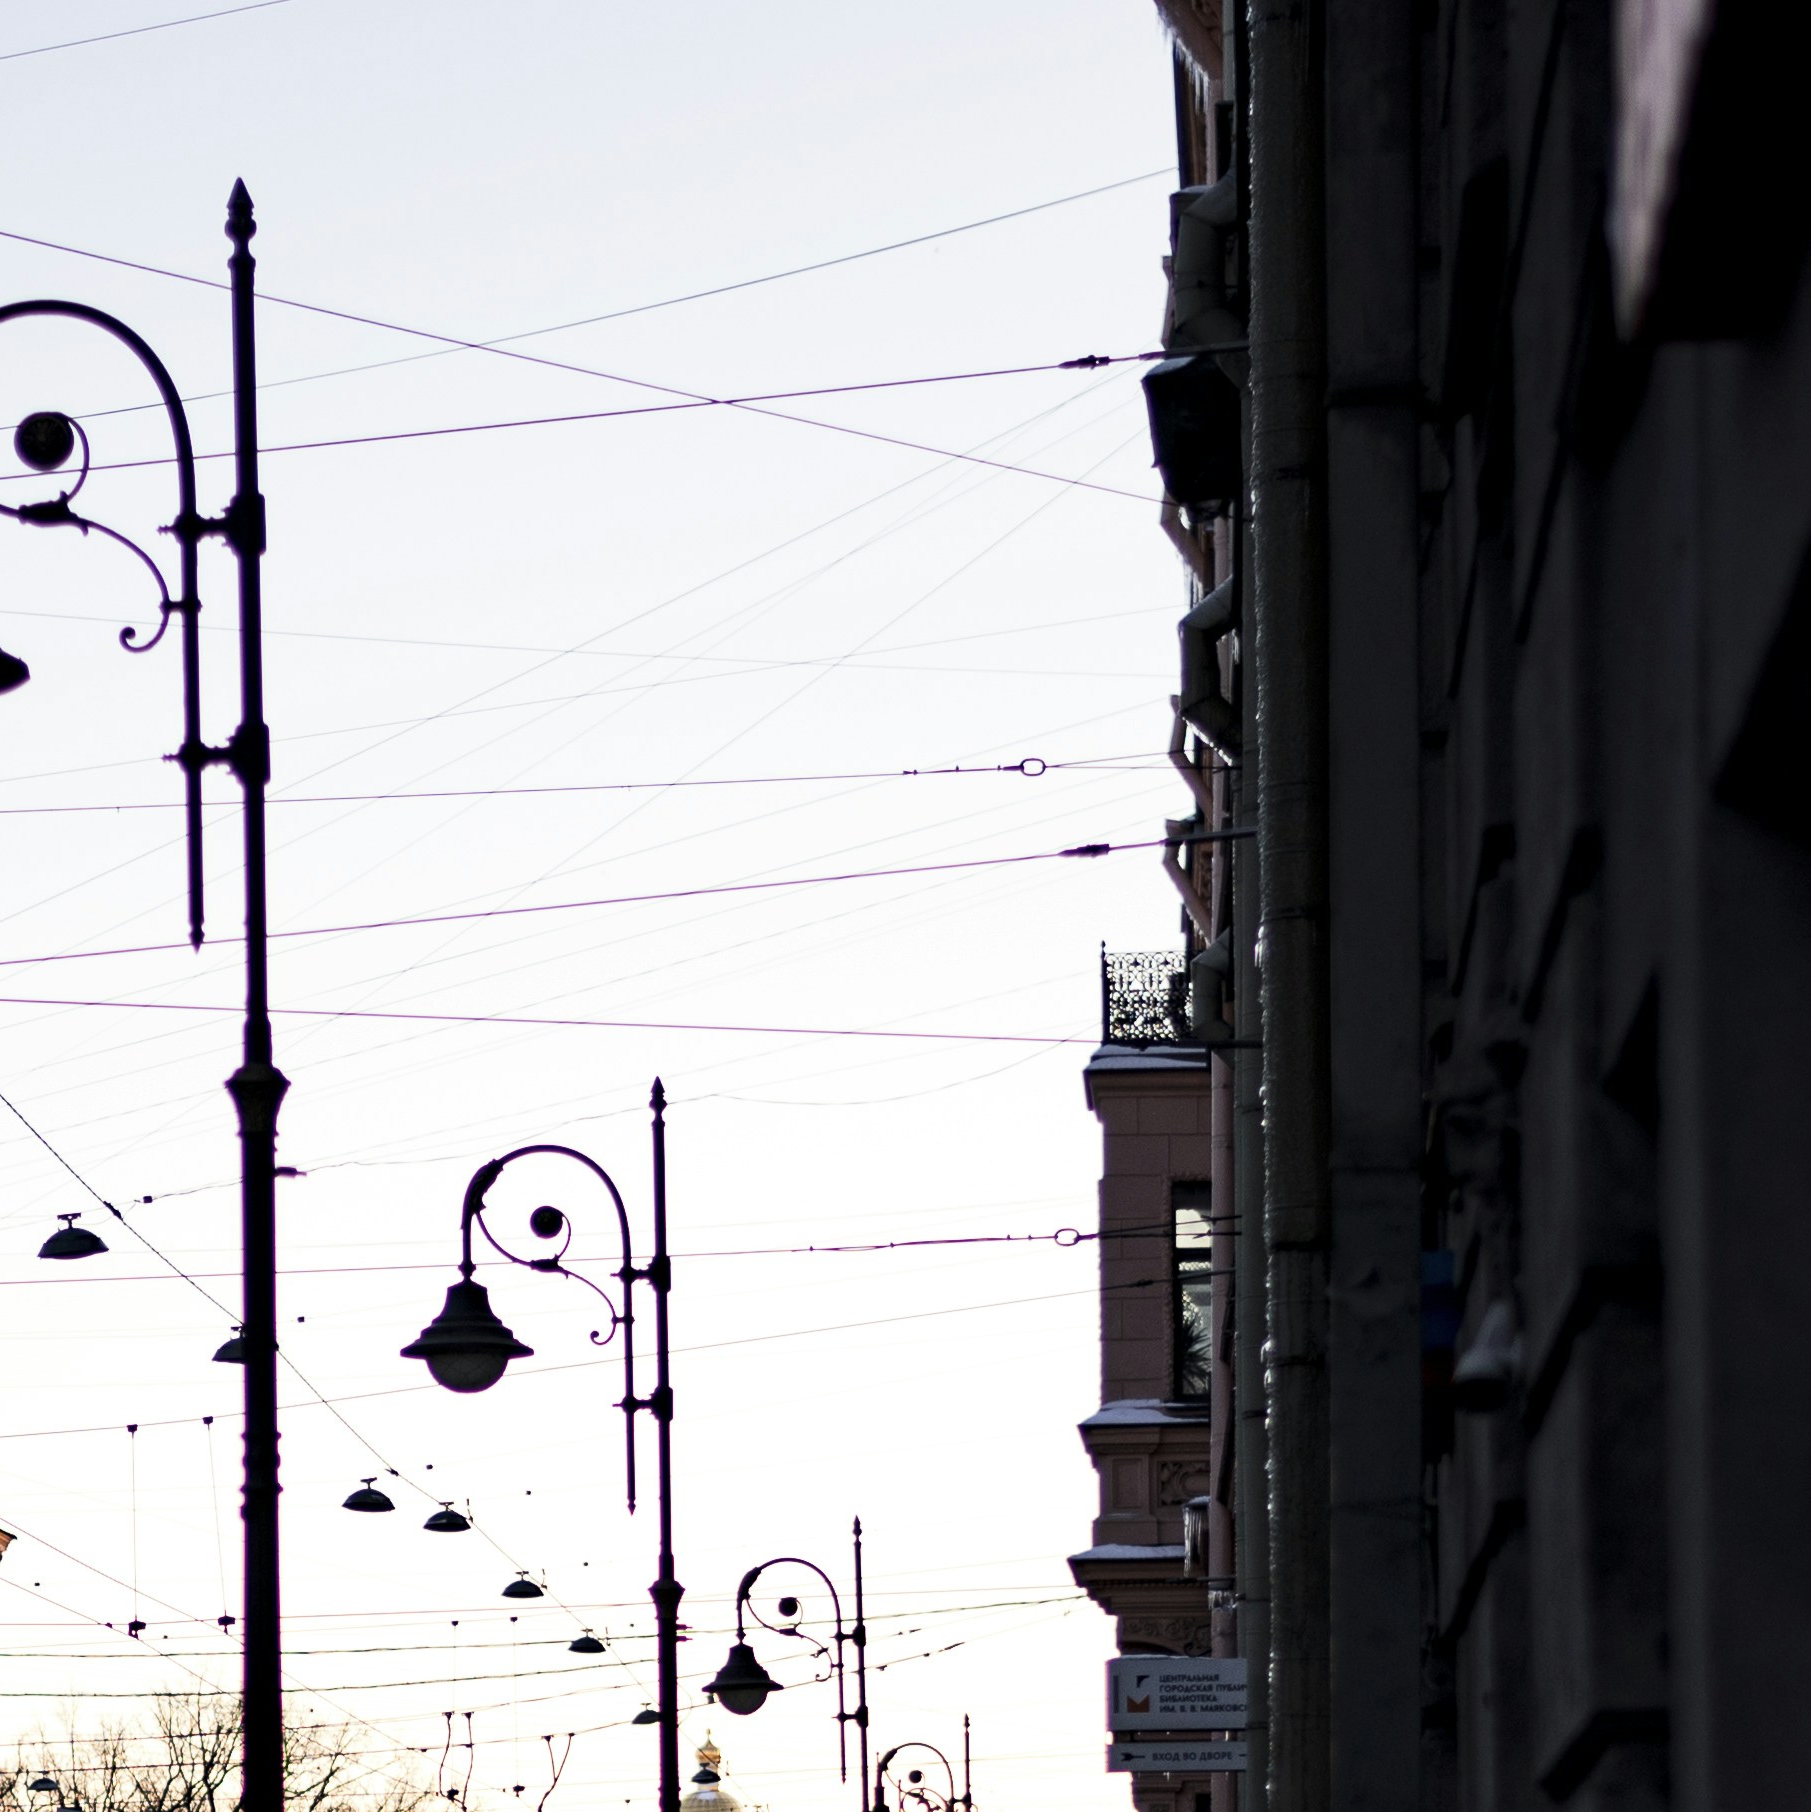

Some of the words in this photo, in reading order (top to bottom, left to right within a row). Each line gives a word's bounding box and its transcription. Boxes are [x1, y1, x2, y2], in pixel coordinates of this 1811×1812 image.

[1159, 1674, 1219, 1683] ЦЕНТРАЛЬНАЯ
[1159, 1684, 1213, 1693] ГОРОДСКАЯ
[1159, 1694, 1218, 1703] БИБЛИОТЕКА
[1152, 1752, 1181, 1762] ВХОД
[1182, 1752, 1197, 1761] ВО
[1199, 1751, 1232, 1761] ДВОРЕ
